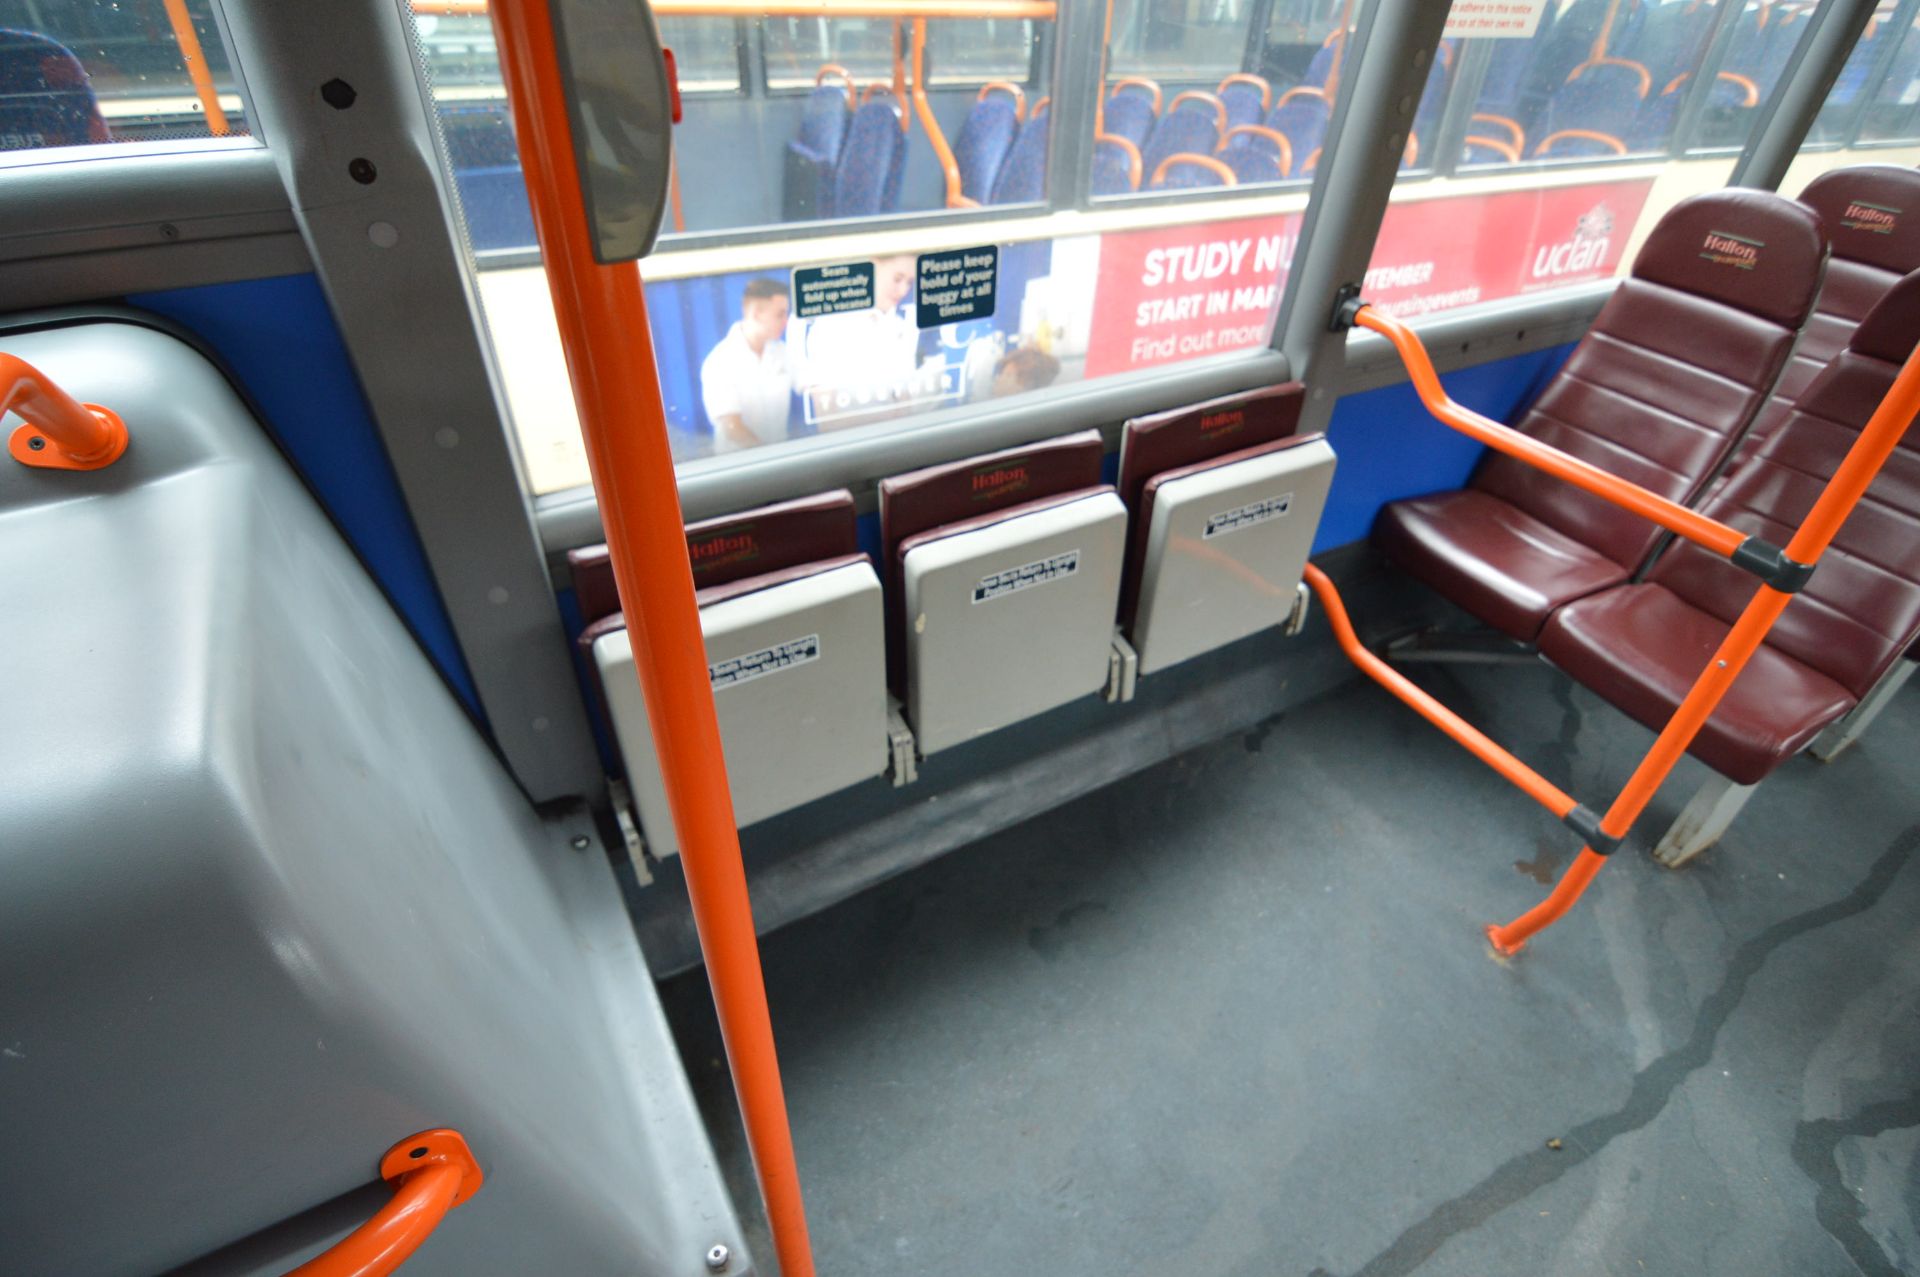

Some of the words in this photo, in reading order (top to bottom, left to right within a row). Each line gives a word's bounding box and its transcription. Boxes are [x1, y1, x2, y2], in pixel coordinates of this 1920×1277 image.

[921, 259, 962, 275] Please
[963, 254, 994, 269] keep
[1141, 238, 1252, 288] STUDY
[1531, 233, 1610, 278] uclan
[821, 266, 850, 278] Seats
[920, 273, 949, 290] hold
[950, 270, 965, 285] of
[965, 269, 994, 287] your
[801, 274, 869, 293] automatically
[921, 290, 959, 306] buggy
[960, 286, 975, 299] at
[976, 282, 992, 297] all
[825, 291, 840, 303] up
[840, 287, 868, 299] when
[800, 304, 822, 316] seat
[823, 303, 833, 313] is
[833, 296, 872, 311] vacated
[939, 302, 974, 318] times
[1135, 294, 1204, 328] START
[1205, 289, 1229, 316] IN
[1131, 333, 1177, 363] Find
[1179, 328, 1214, 354] out
